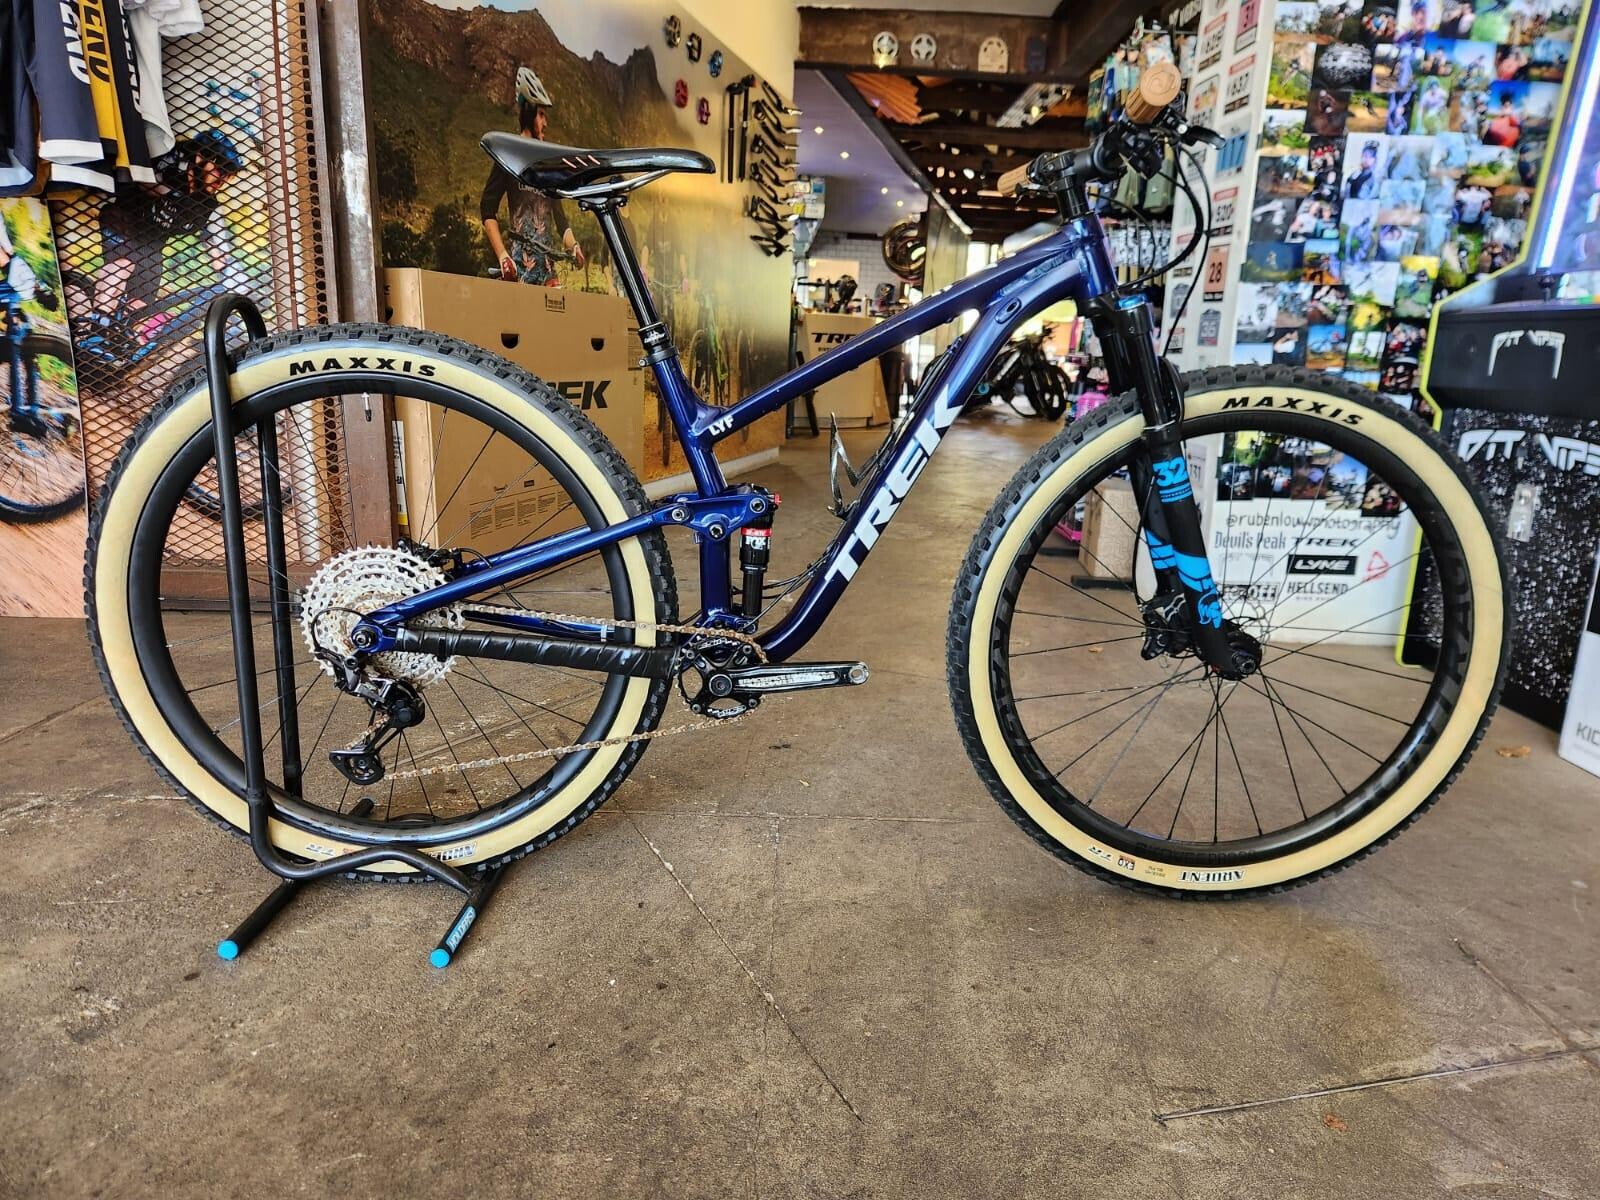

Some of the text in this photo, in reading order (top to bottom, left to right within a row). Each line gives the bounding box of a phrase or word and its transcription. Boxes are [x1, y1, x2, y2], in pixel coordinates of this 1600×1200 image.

[59, 0, 91, 85] END
[82, 0, 110, 83] END
[1209, 262, 1222, 283] 28
[289, 356, 436, 378] MAXXIS
[546, 380, 612, 410] EK
[1221, 395, 1364, 426] MAXXIS
[1457, 429, 1526, 463] PIT
[825, 384, 963, 582] TREK
[1153, 456, 1189, 487] 32
[1291, 537, 1359, 548] TREK
[1287, 581, 1349, 595] HELLSEND
[1179, 870, 1245, 883] ARDENT
